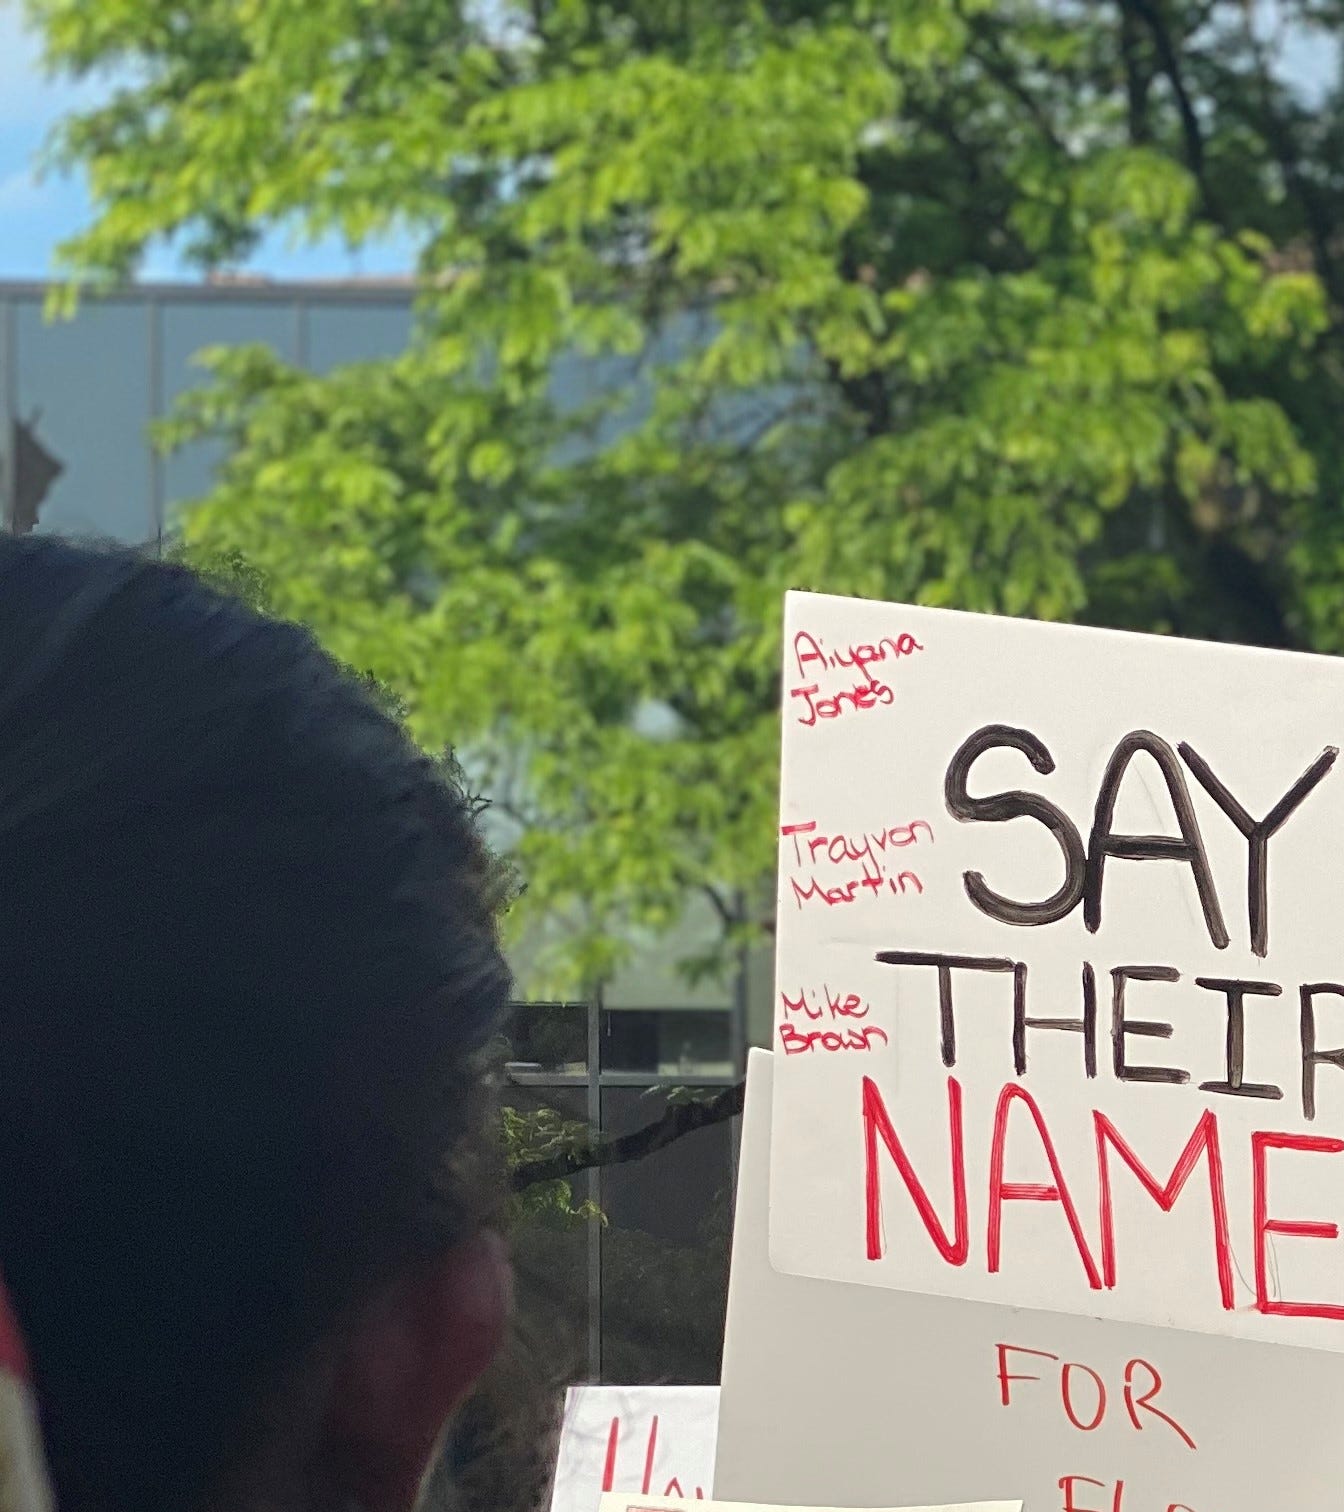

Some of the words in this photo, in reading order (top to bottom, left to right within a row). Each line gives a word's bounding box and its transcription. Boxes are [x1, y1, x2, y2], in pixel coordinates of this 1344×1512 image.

[794, 630, 924, 680] Aiyana
[791, 680, 894, 727] Jones
[782, 821, 934, 881] Trayvon
[944, 724, 1340, 958] SAY
[791, 862, 923, 911] Martin
[781, 983, 870, 1020] Mike
[779, 1023, 888, 1056] Brown
[994, 1342, 1198, 1451] FOR
